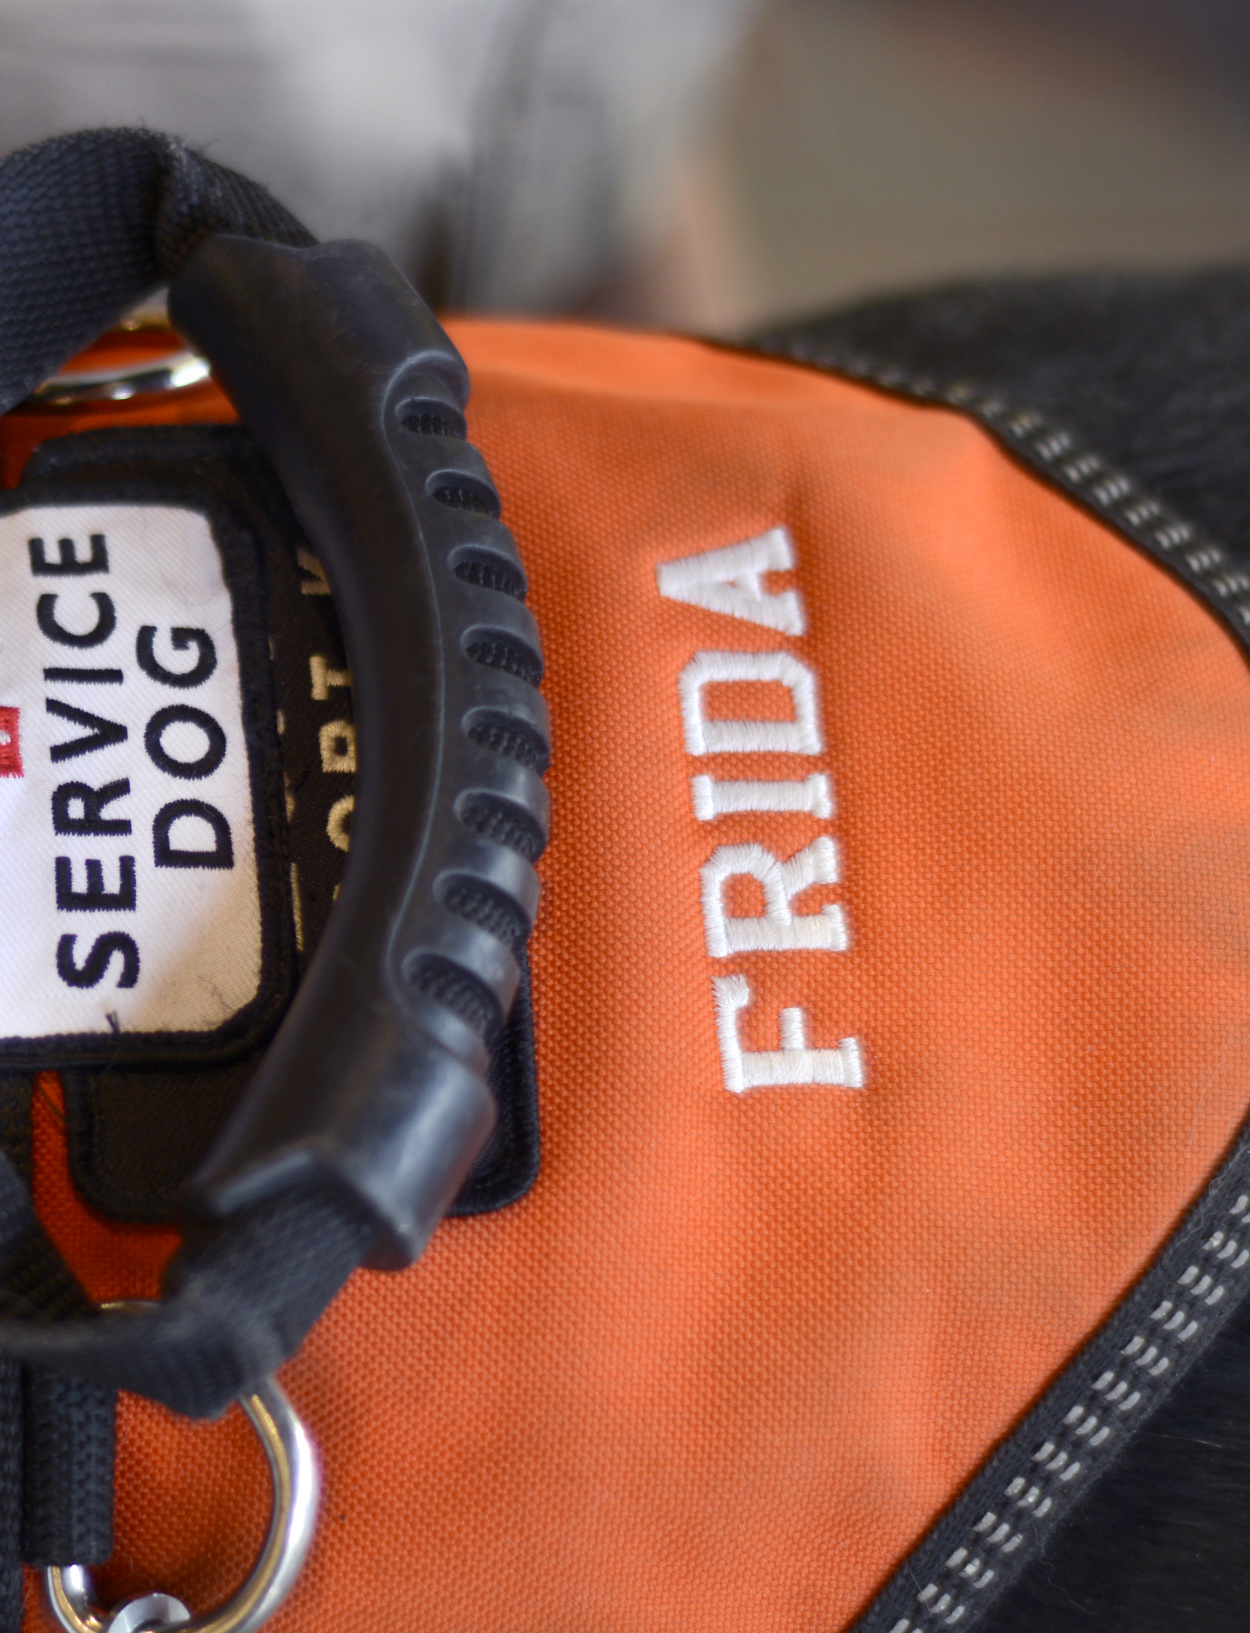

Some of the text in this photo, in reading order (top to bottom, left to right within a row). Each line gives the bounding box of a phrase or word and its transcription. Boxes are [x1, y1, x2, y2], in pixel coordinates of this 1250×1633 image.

[29, 533, 141, 989] SERVICE
[136, 624, 234, 870] DOG
[656, 526, 864, 1093] FRIDA
